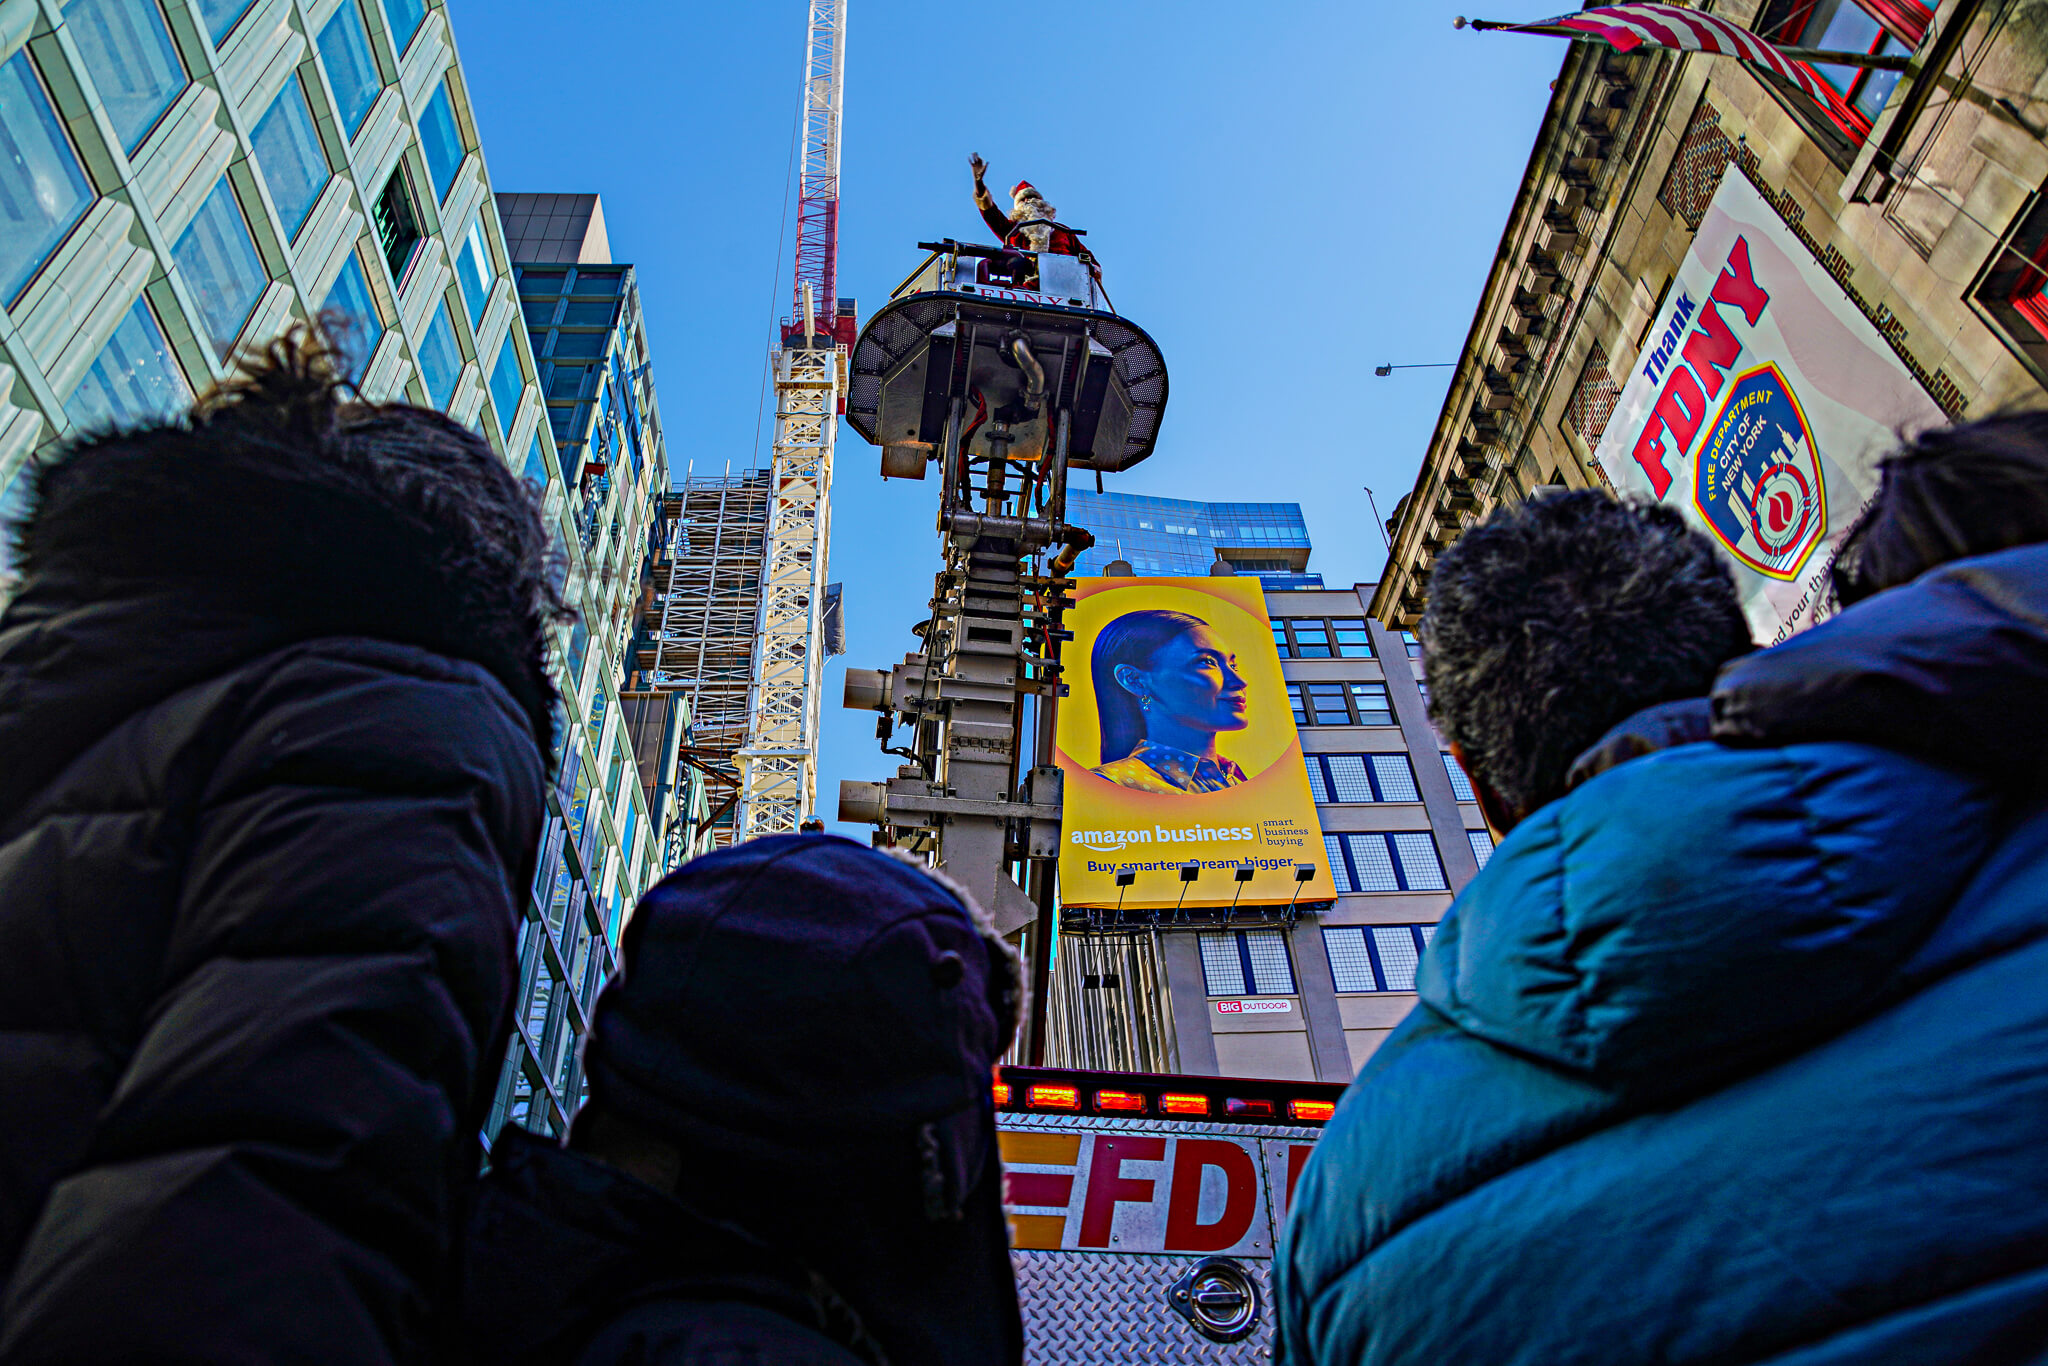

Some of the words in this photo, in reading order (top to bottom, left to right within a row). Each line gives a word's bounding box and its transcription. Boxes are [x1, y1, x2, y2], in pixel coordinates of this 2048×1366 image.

[1643, 291, 1696, 387] Thank
[1632, 234, 1770, 502] FDNY
[1710, 390, 1773, 459] DEPARTMENT
[1720, 433, 1739, 469] CITY
[1738, 412, 1751, 436] OF
[1721, 455, 1743, 491] NEW
[1740, 414, 1767, 456] YORK
[1708, 463, 1717, 501] FIRE
[1785, 592, 1809, 633] your
[1071, 830, 1152, 845] amazon
[1155, 824, 1254, 843] business
[1263, 819, 1294, 827] smart
[1264, 828, 1309, 836] business
[1266, 837, 1304, 847] buying
[1087, 861, 1117, 874] Buy
[1220, 1002, 1241, 1012] BIG
[1243, 1002, 1288, 1010] OUTDOOR
